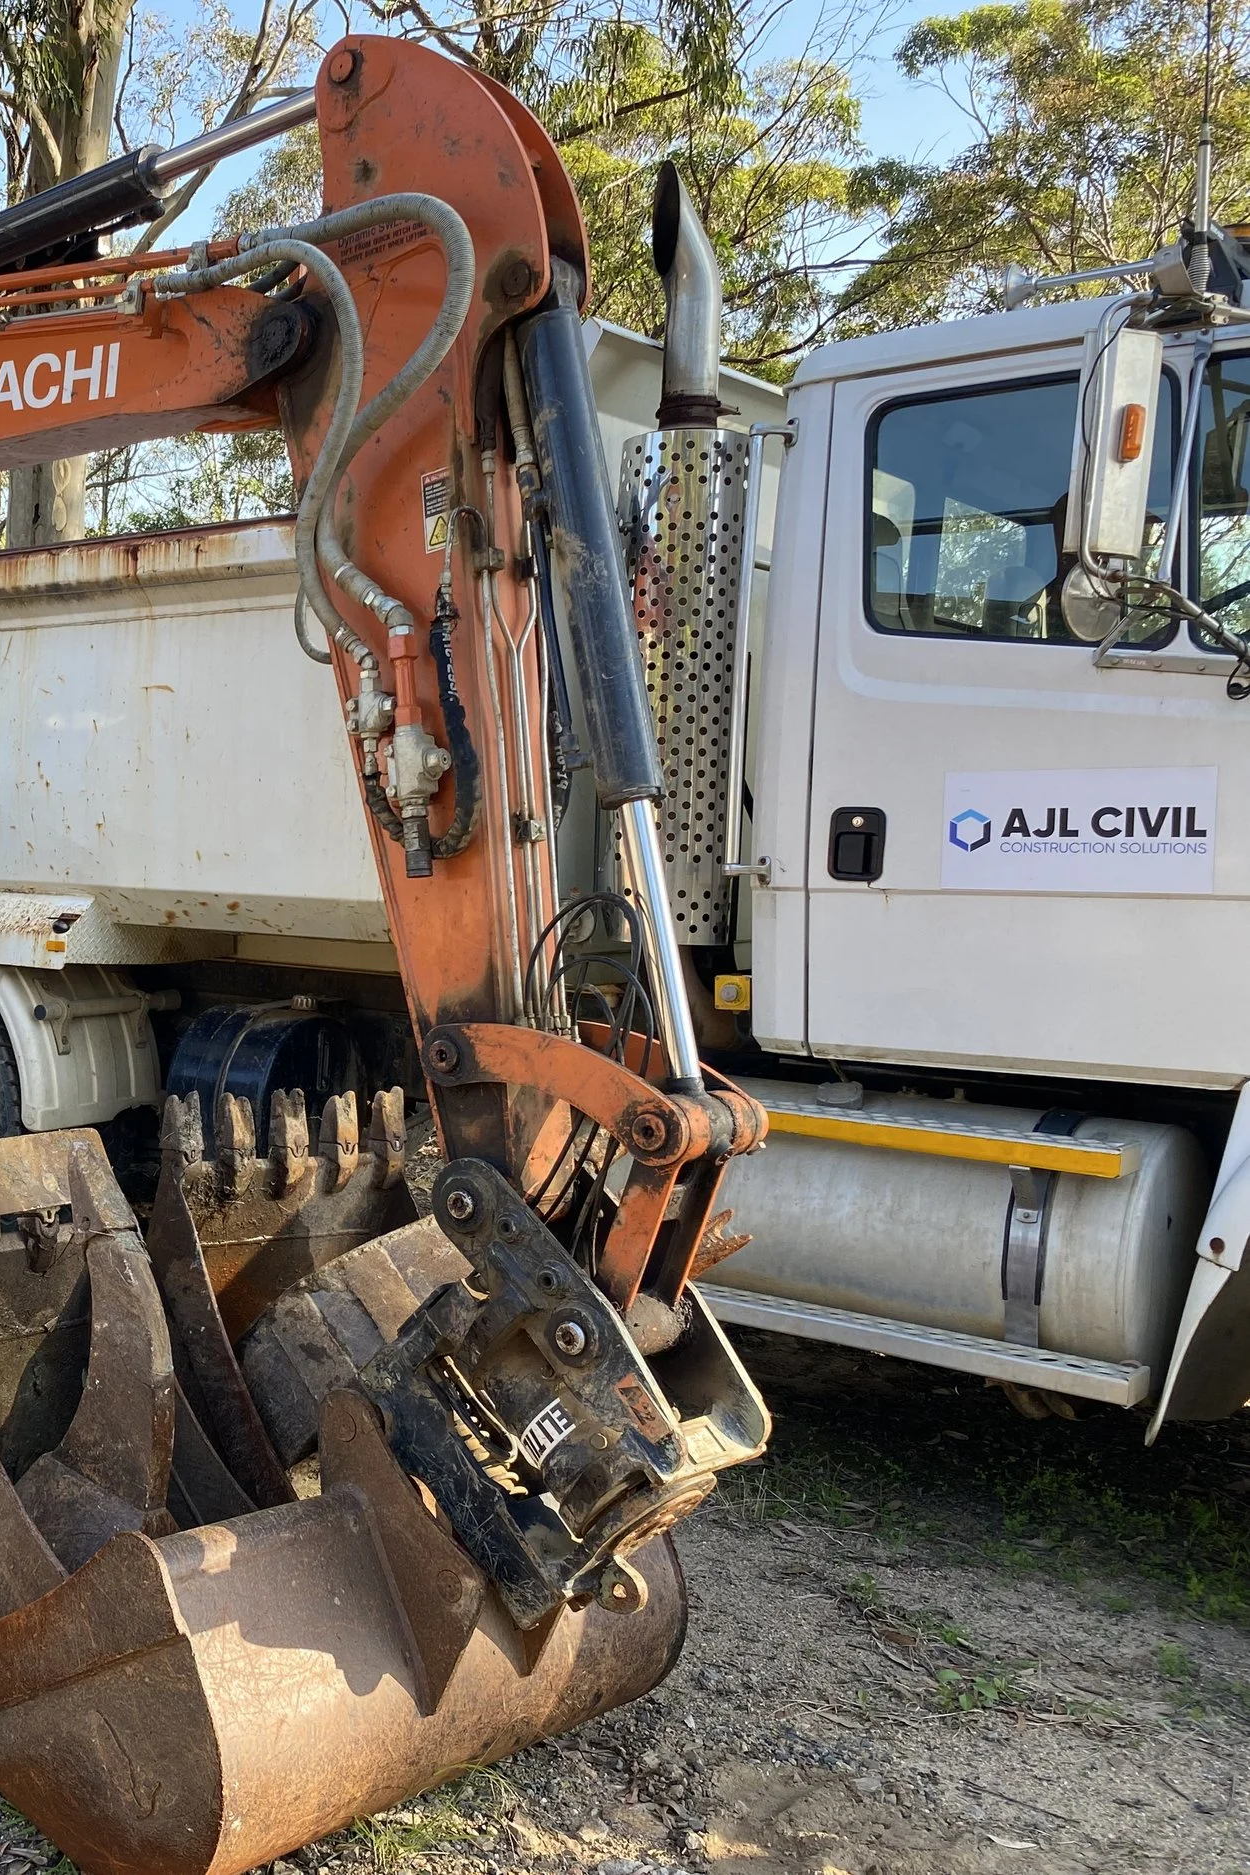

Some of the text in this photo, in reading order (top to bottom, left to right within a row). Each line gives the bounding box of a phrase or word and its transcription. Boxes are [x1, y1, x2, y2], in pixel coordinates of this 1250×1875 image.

[1000, 806, 1207, 838] AJL CIVIL
[1000, 841, 1207, 855] CONSTRUCTION SOLUTIONS
